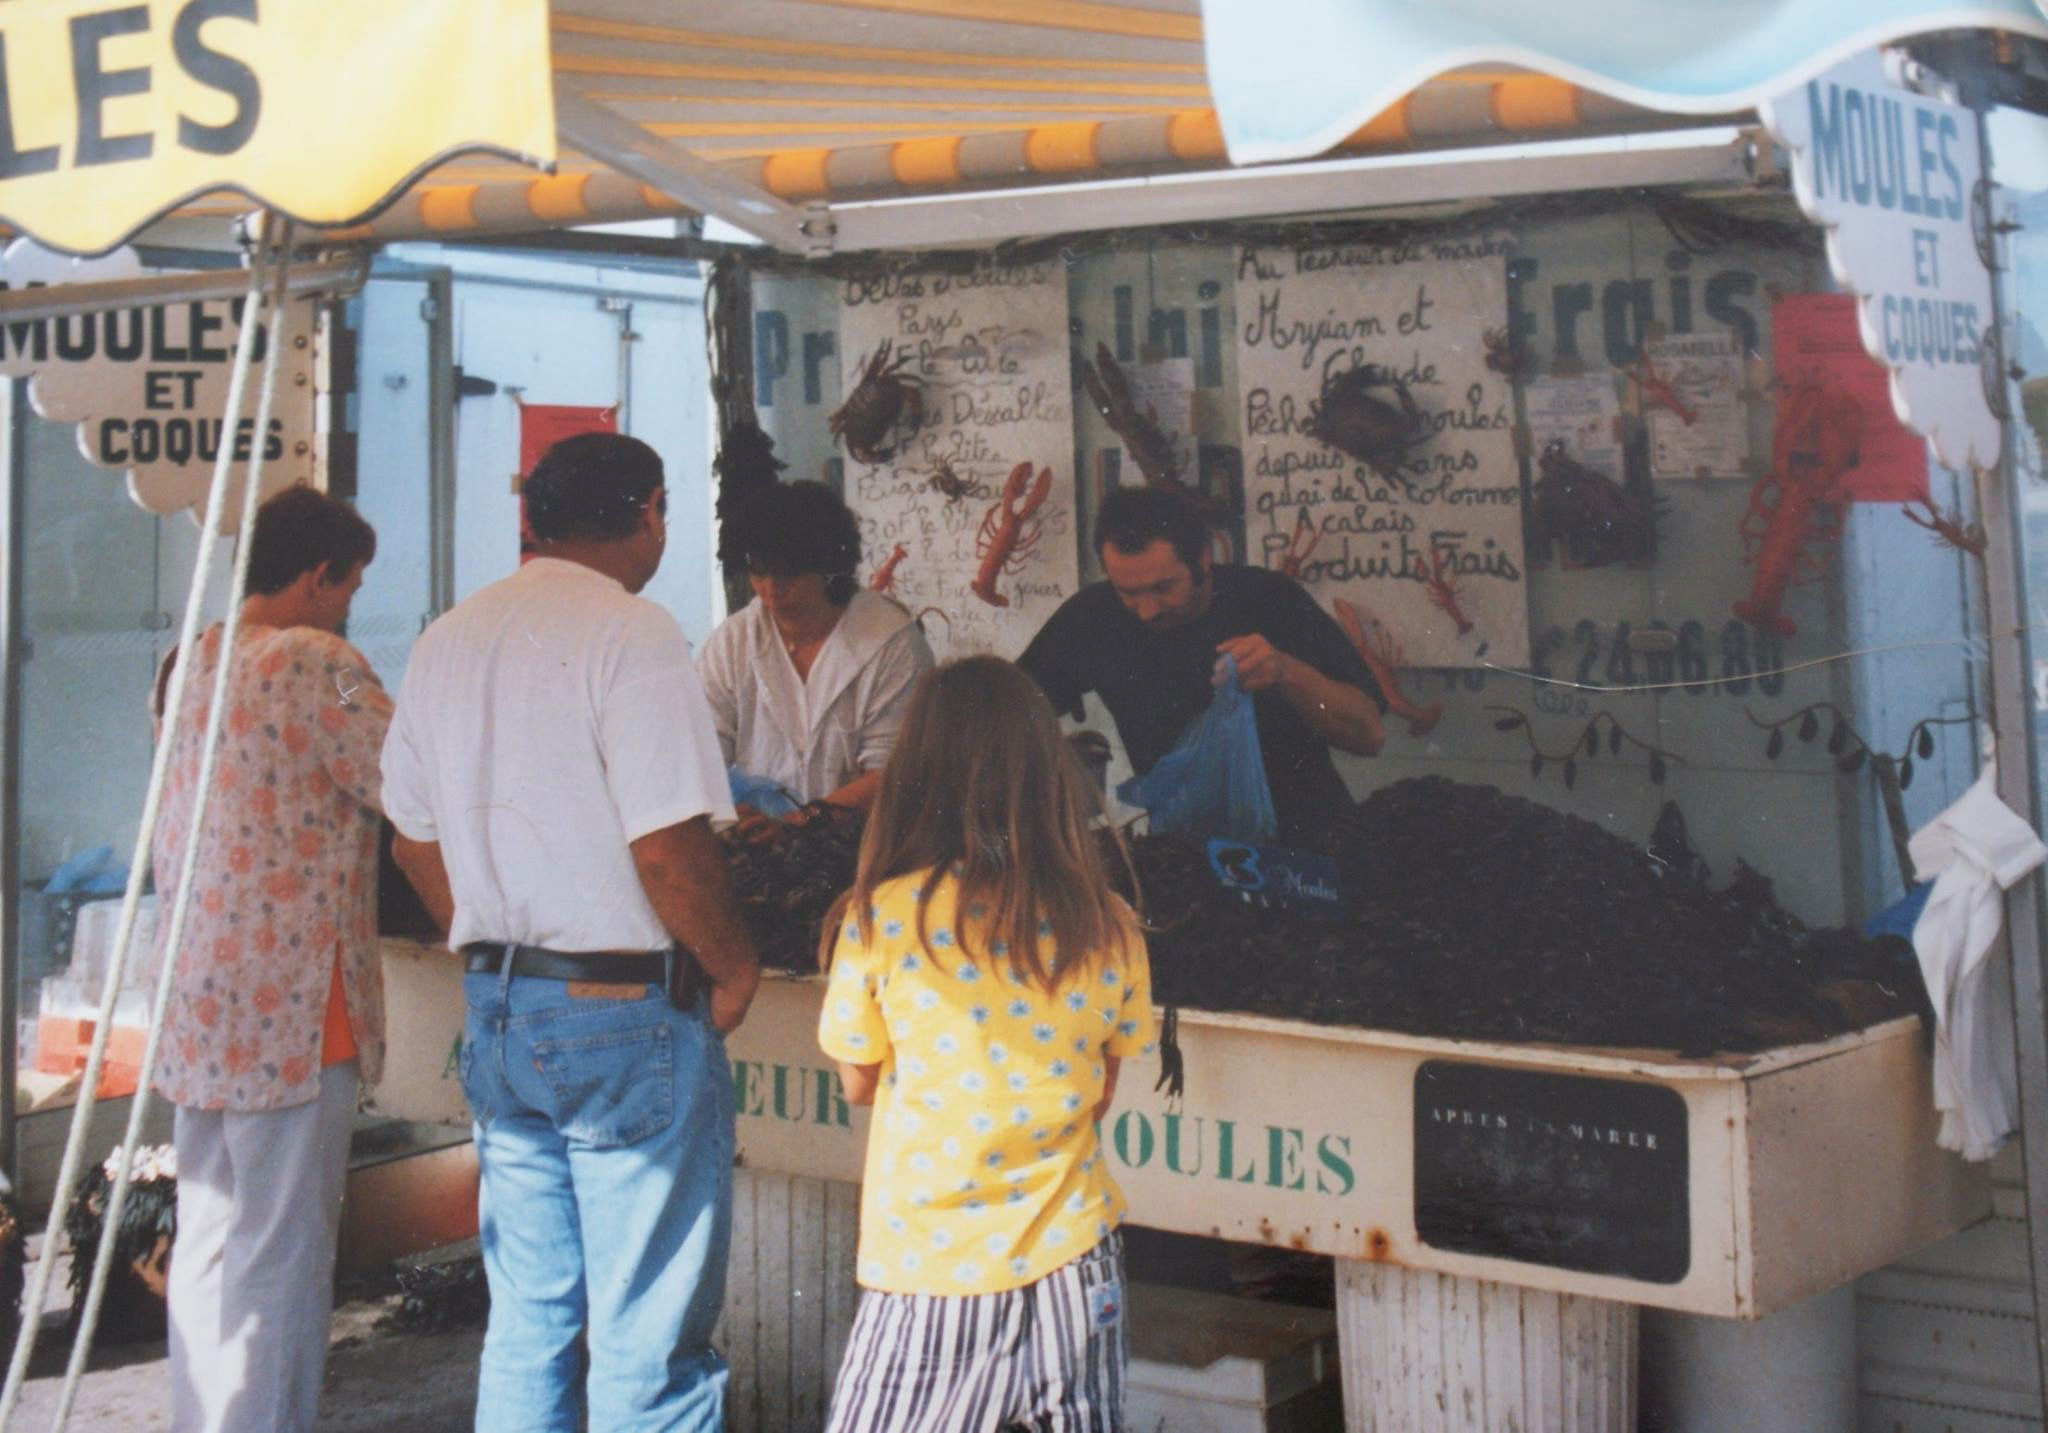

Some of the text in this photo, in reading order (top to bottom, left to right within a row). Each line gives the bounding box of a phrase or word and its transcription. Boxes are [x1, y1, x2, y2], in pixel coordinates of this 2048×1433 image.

[1808, 79, 1964, 222] MOULES
[1912, 228, 1940, 288] ET
[1399, 284, 1434, 336] et
[1881, 294, 1985, 369] COQUES
[145, 371, 203, 409] ET
[1323, 345, 1443, 388] Clude
[100, 417, 283, 467] COQUES
[1262, 533, 1428, 583] Poduits
[734, 1061, 852, 1128] EUR
[1094, 1109, 1356, 1197] OULES
